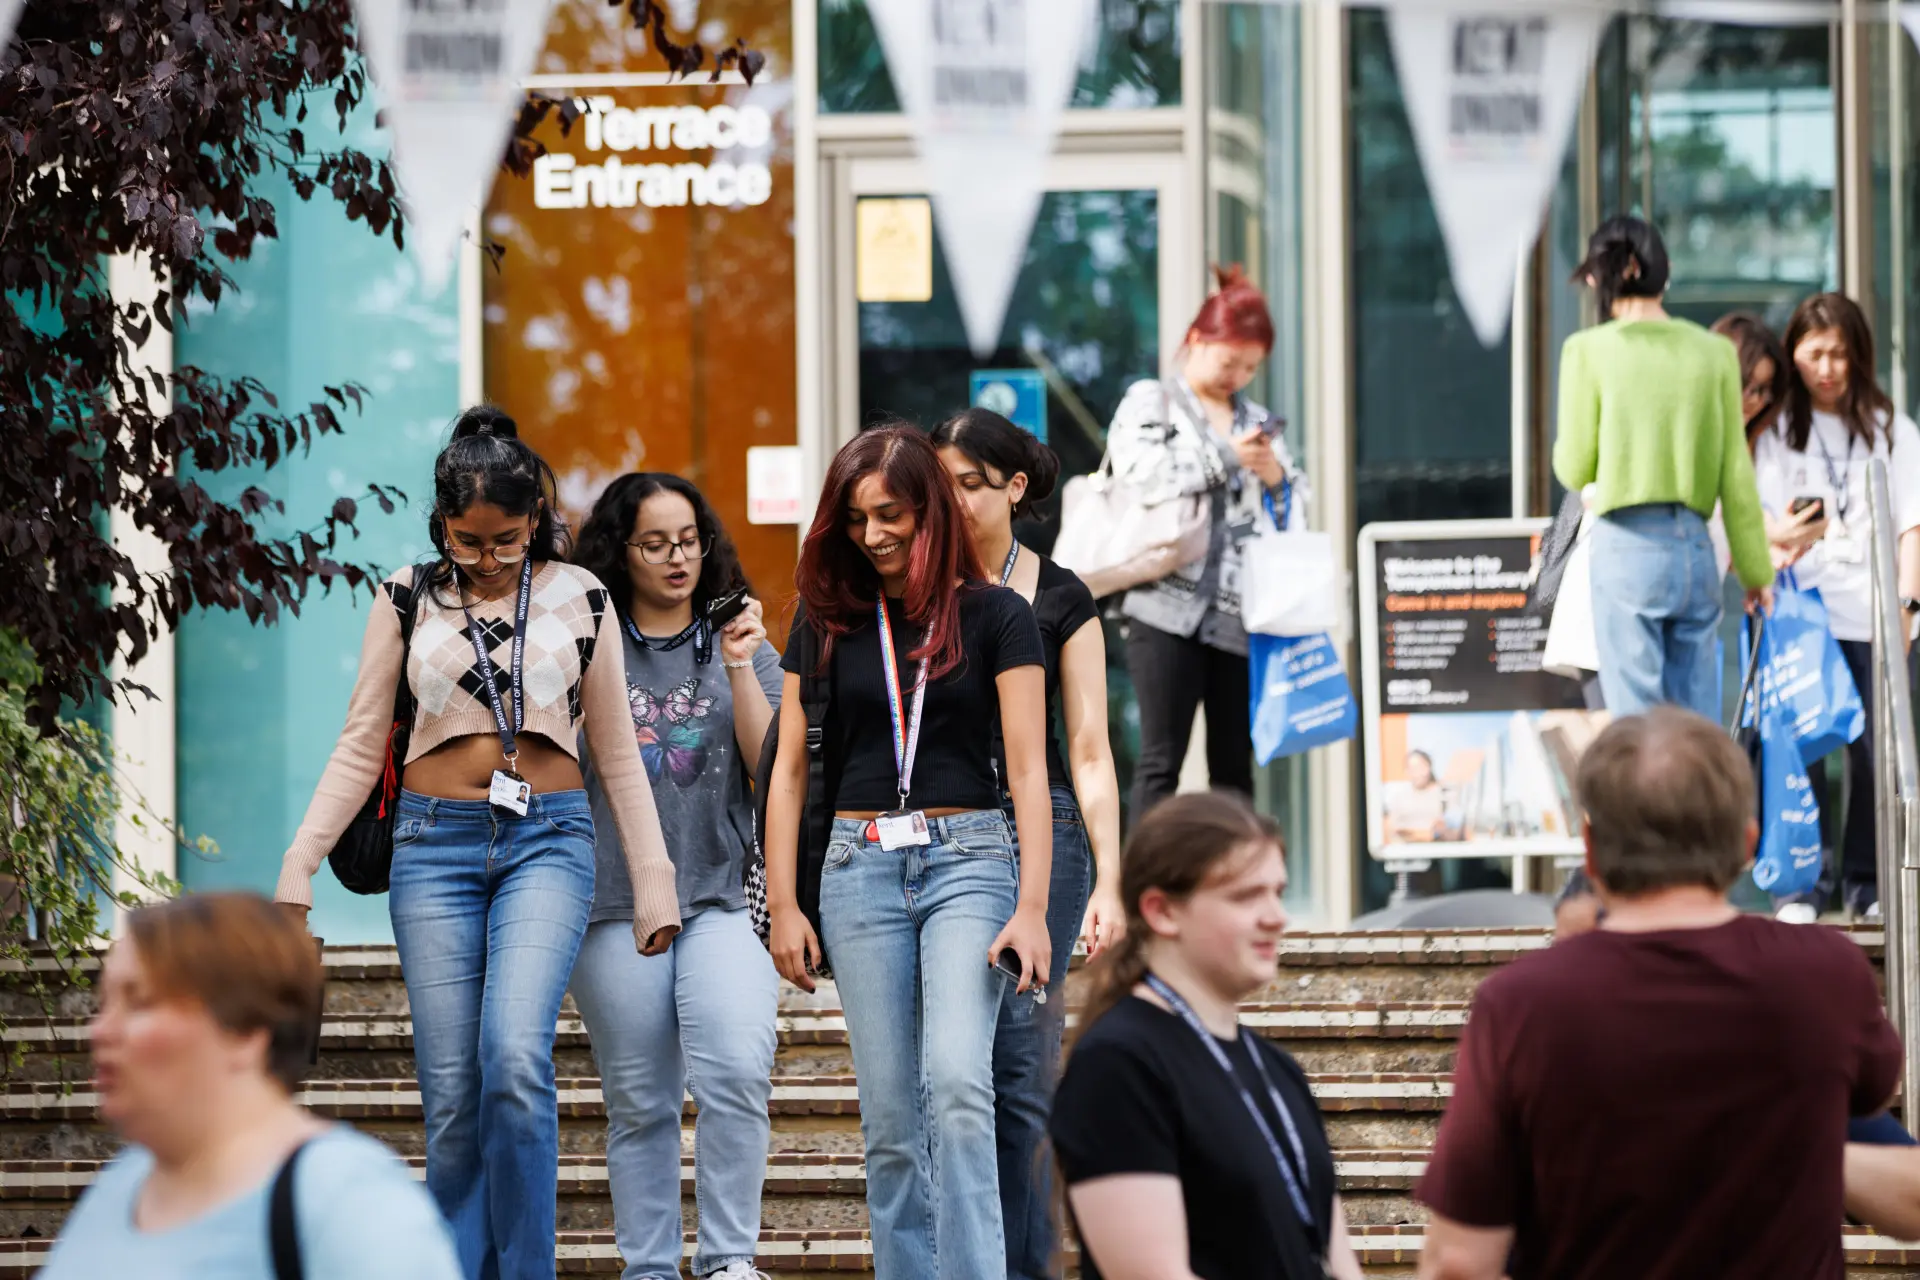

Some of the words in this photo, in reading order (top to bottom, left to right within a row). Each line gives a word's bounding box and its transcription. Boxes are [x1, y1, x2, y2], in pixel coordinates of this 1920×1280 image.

[573, 95, 771, 151] Terrace
[534, 153, 771, 208] Entrance
[523, 575, 530, 585] OF
[518, 584, 529, 620] UNIVERSITY
[473, 629, 489, 667] UNIVERSITY
[514, 636, 522, 666] STUDENT
[483, 669, 491, 678] OF
[486, 680, 498, 698] KENT
[514, 687, 520, 697] OF
[493, 700, 508, 732] STUDENT
[903, 727, 915, 769] UNIVERSITY
[910, 717, 916, 727] OF
